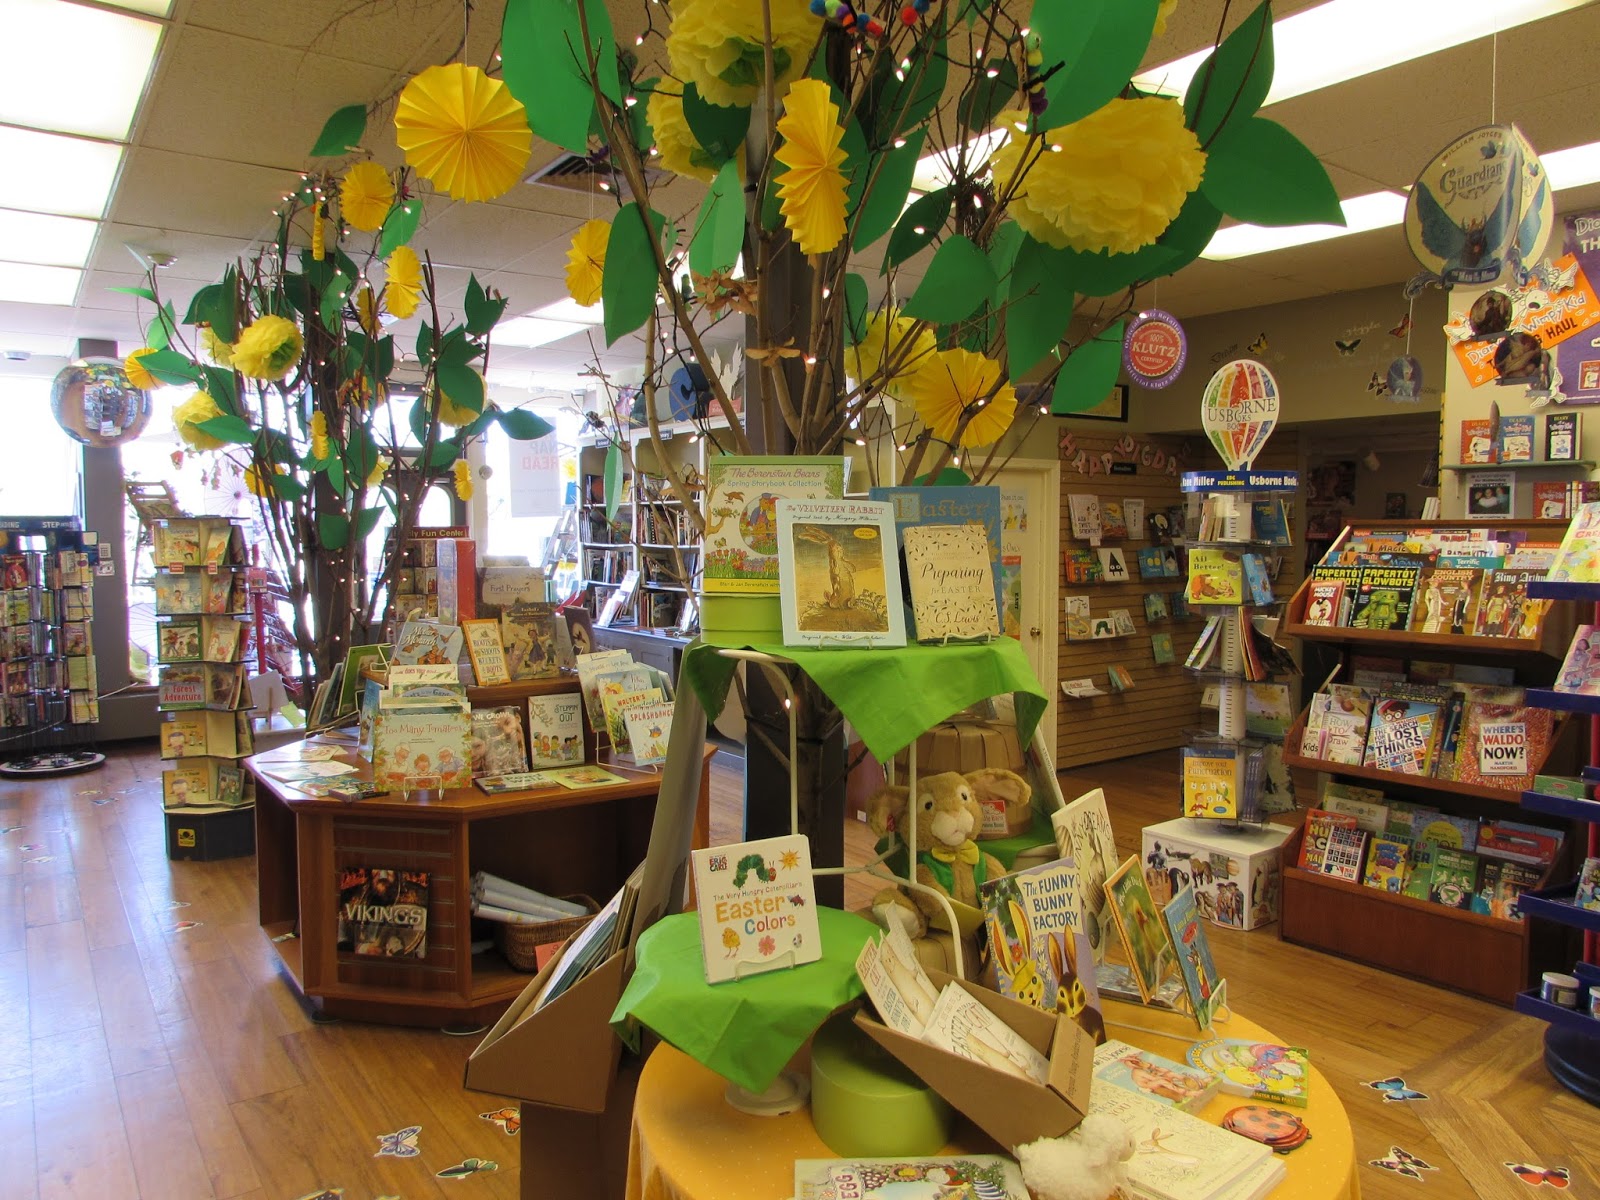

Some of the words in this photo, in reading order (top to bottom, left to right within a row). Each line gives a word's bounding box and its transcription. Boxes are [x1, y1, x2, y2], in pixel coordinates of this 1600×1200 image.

[1442, 136, 1474, 160] WILLIAM
[1521, 304, 1563, 333] Wimpy
[1564, 292, 1586, 310] Kid
[1158, 313, 1181, 335] Retailer
[1546, 317, 1578, 340] HAUL
[1132, 341, 1176, 358] KLUTZ
[1140, 356, 1163, 364] CERTIFIED
[1127, 364, 1149, 387] Official
[1151, 380, 1168, 388] Klutz
[1208, 398, 1276, 422] USBORNE
[730, 468, 746, 478] The
[747, 467, 791, 478] Berenstain
[793, 468, 820, 478] Bears
[727, 480, 750, 488] Spring
[752, 480, 786, 488] Storybook
[1193, 475, 1215, 487] Miller
[1250, 475, 1282, 486] Usborne
[797, 504, 846, 513] VELVETEEN
[848, 504, 885, 515] RABBIT
[895, 496, 988, 518] Easter
[42, 521, 60, 529] STEP
[421, 529, 437, 538] Fun
[1378, 544, 1406, 552] MAGIC
[1389, 559, 1424, 567] MOANA
[1456, 558, 1480, 566] Terrific
[921, 562, 985, 586] Preparing
[1363, 568, 1416, 578] PAPERTOY
[1520, 572, 1547, 582] Arthu
[1362, 576, 1415, 587] GLOWBOTS
[490, 584, 504, 592] First
[507, 584, 531, 594] Prayers
[941, 586, 981, 594] EASTER
[954, 611, 981, 624] Lewis
[172, 685, 196, 693] Forest
[164, 693, 202, 702] Adventure
[617, 693, 647, 706] WALTER'S
[559, 713, 576, 723] OUT
[384, 725, 398, 734] Too
[400, 723, 424, 736] Many
[426, 723, 463, 733] Tomatoes
[1390, 720, 1418, 731] SEARCH
[1483, 725, 1524, 734] WHERE'S
[1388, 726, 1419, 741] LOST
[1483, 734, 1523, 745] WALDO
[1303, 742, 1319, 752] Kids
[1376, 736, 1423, 757] THINGS
[1484, 747, 1524, 760] NOW?
[1188, 768, 1232, 776] Punctuation
[1023, 881, 1038, 898] The
[1039, 873, 1076, 895] FUNNY
[725, 891, 741, 899] Very
[742, 888, 764, 897] Hungry
[1033, 892, 1074, 913] BUNNY
[345, 903, 422, 925] VIKINGS
[715, 895, 785, 924] Easter
[744, 914, 796, 935] Colors
[1033, 910, 1079, 931] FACTORY
[835, 1174, 859, 1199] EGG
